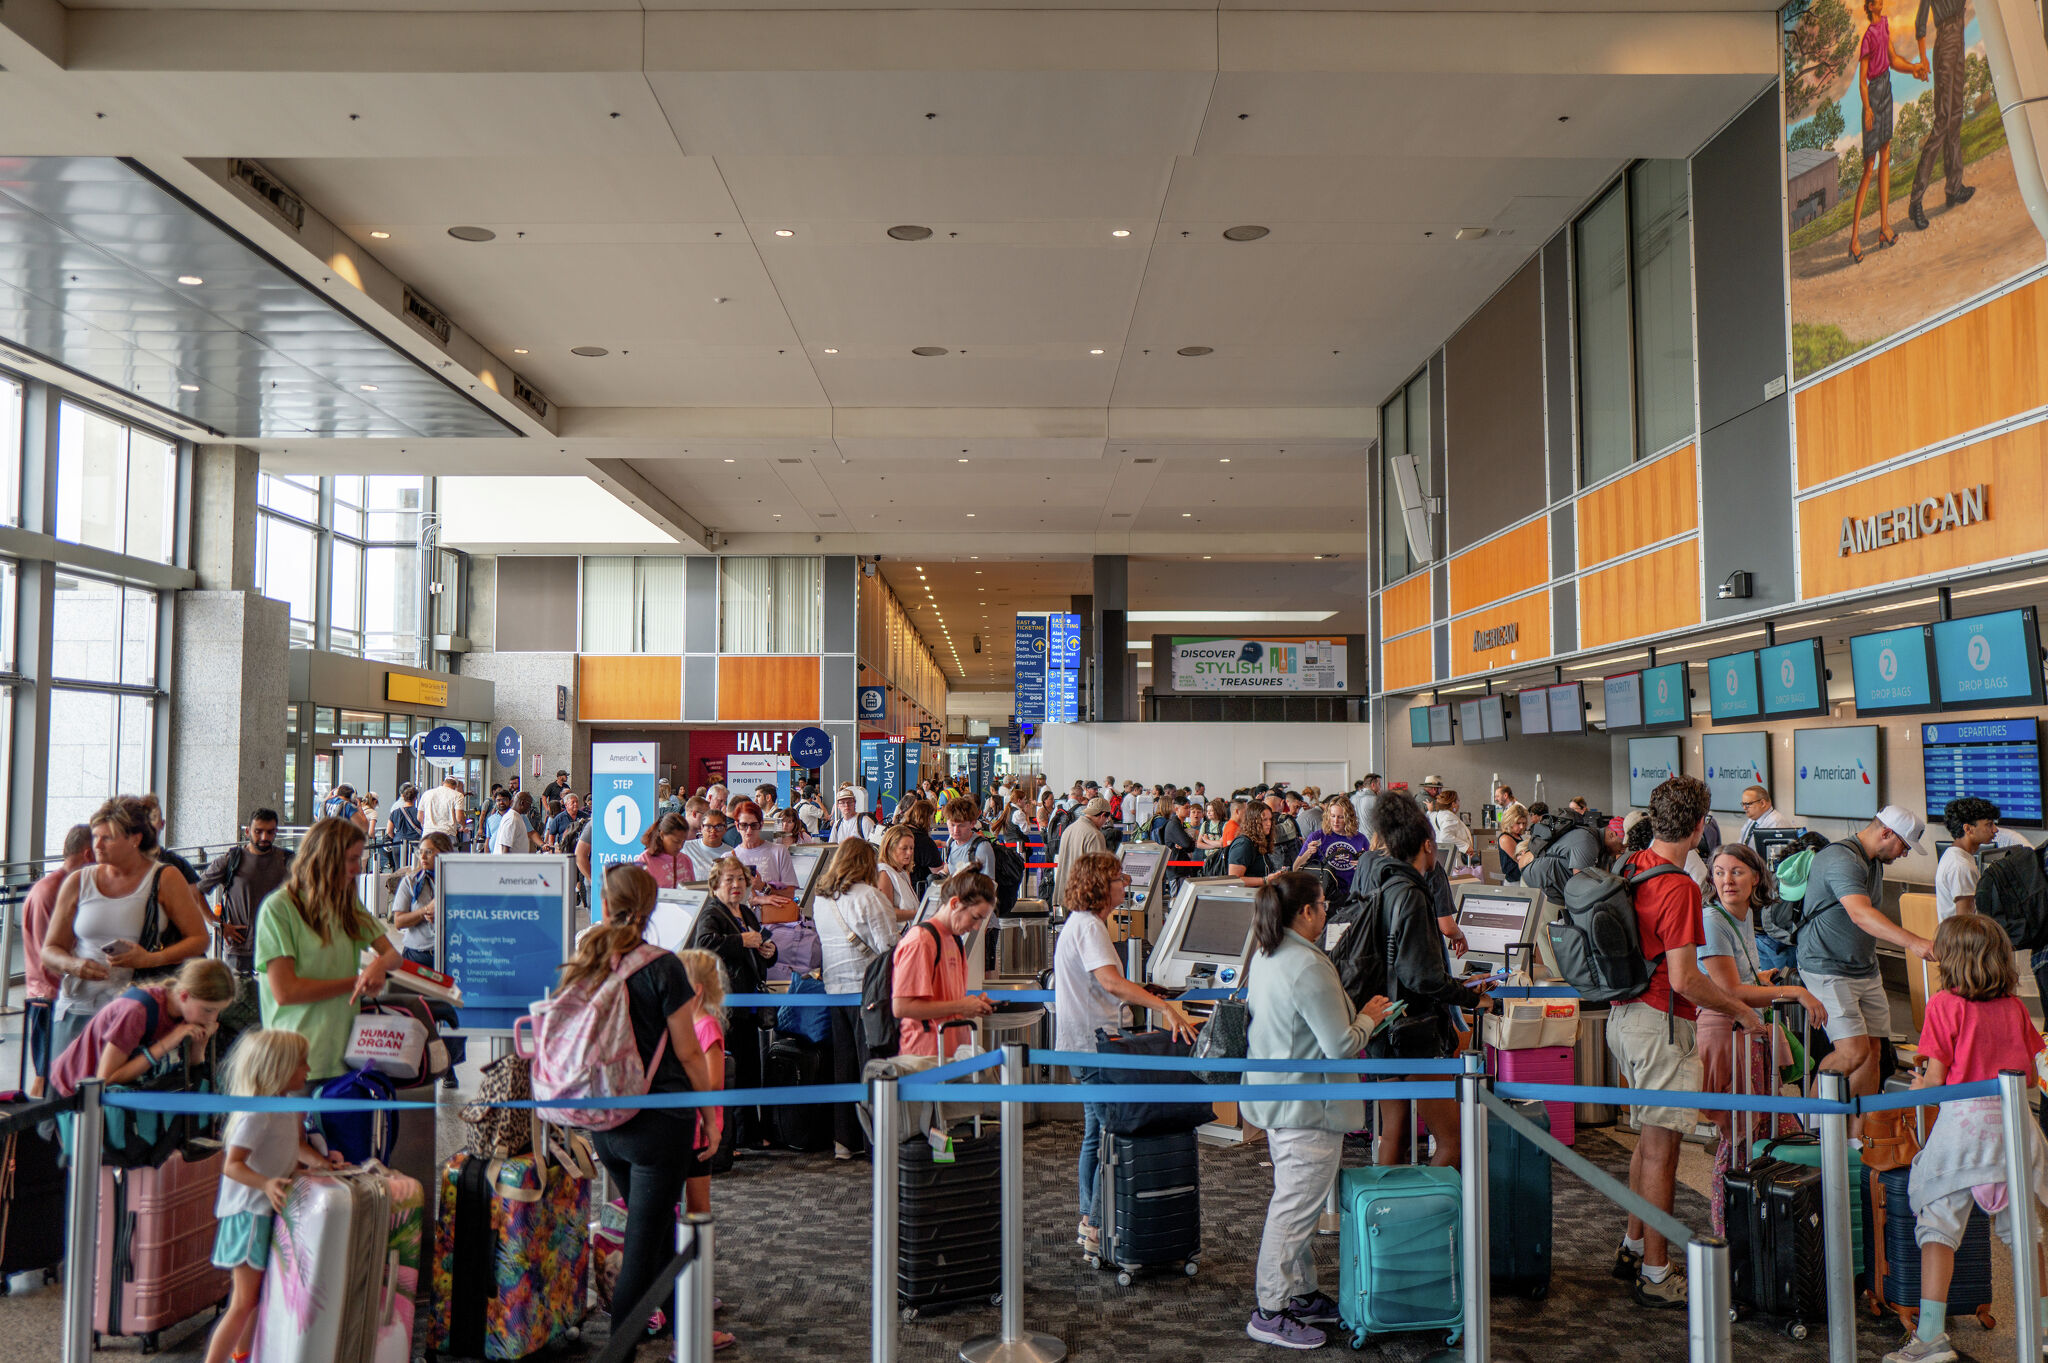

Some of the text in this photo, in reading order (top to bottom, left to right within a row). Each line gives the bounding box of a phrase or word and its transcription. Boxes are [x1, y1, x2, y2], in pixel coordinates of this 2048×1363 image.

[1838, 484, 1985, 557] AMERICAN
[2023, 611, 2032, 621] 41
[1924, 628, 1931, 636] 42
[1969, 624, 1984, 634] STEP
[1473, 622, 1516, 652] AMERICAN
[1880, 638, 1892, 647] STEP
[1181, 650, 1236, 659] DISCOVER
[1973, 642, 1985, 666] 2
[1195, 662, 1263, 674] STYLISH
[1884, 654, 1893, 676] 2
[1220, 678, 1283, 686] TREASURES
[1606, 681, 1630, 694] PRIORITY
[1959, 677, 2008, 692] DROP BAGS
[1872, 686, 1912, 700] DROP BAGS
[1776, 695, 1790, 704] DROP
[1958, 725, 2007, 738] DEPARTURES
[736, 732, 783, 752] HALF
[889, 736, 905, 744] HALF
[800, 748, 823, 756] CLEAR
[610, 754, 638, 762] American
[884, 748, 894, 790] TSA Pre
[982, 752, 990, 786] TSA Pre
[1641, 767, 1667, 779] American
[1718, 766, 1752, 779] American
[1814, 765, 1856, 780] American
[613, 780, 634, 790] STEP
[616, 805, 626, 836] 1
[598, 853, 618, 864] TAG
[499, 877, 538, 886] American
[448, 910, 540, 920] SPECIAL SERVICES
[467, 936, 516, 944] Overweight bags
[467, 969, 516, 977] Unaccompanied
[360, 1029, 405, 1040] HUMAN
[357, 1038, 402, 1050] ORGAN
